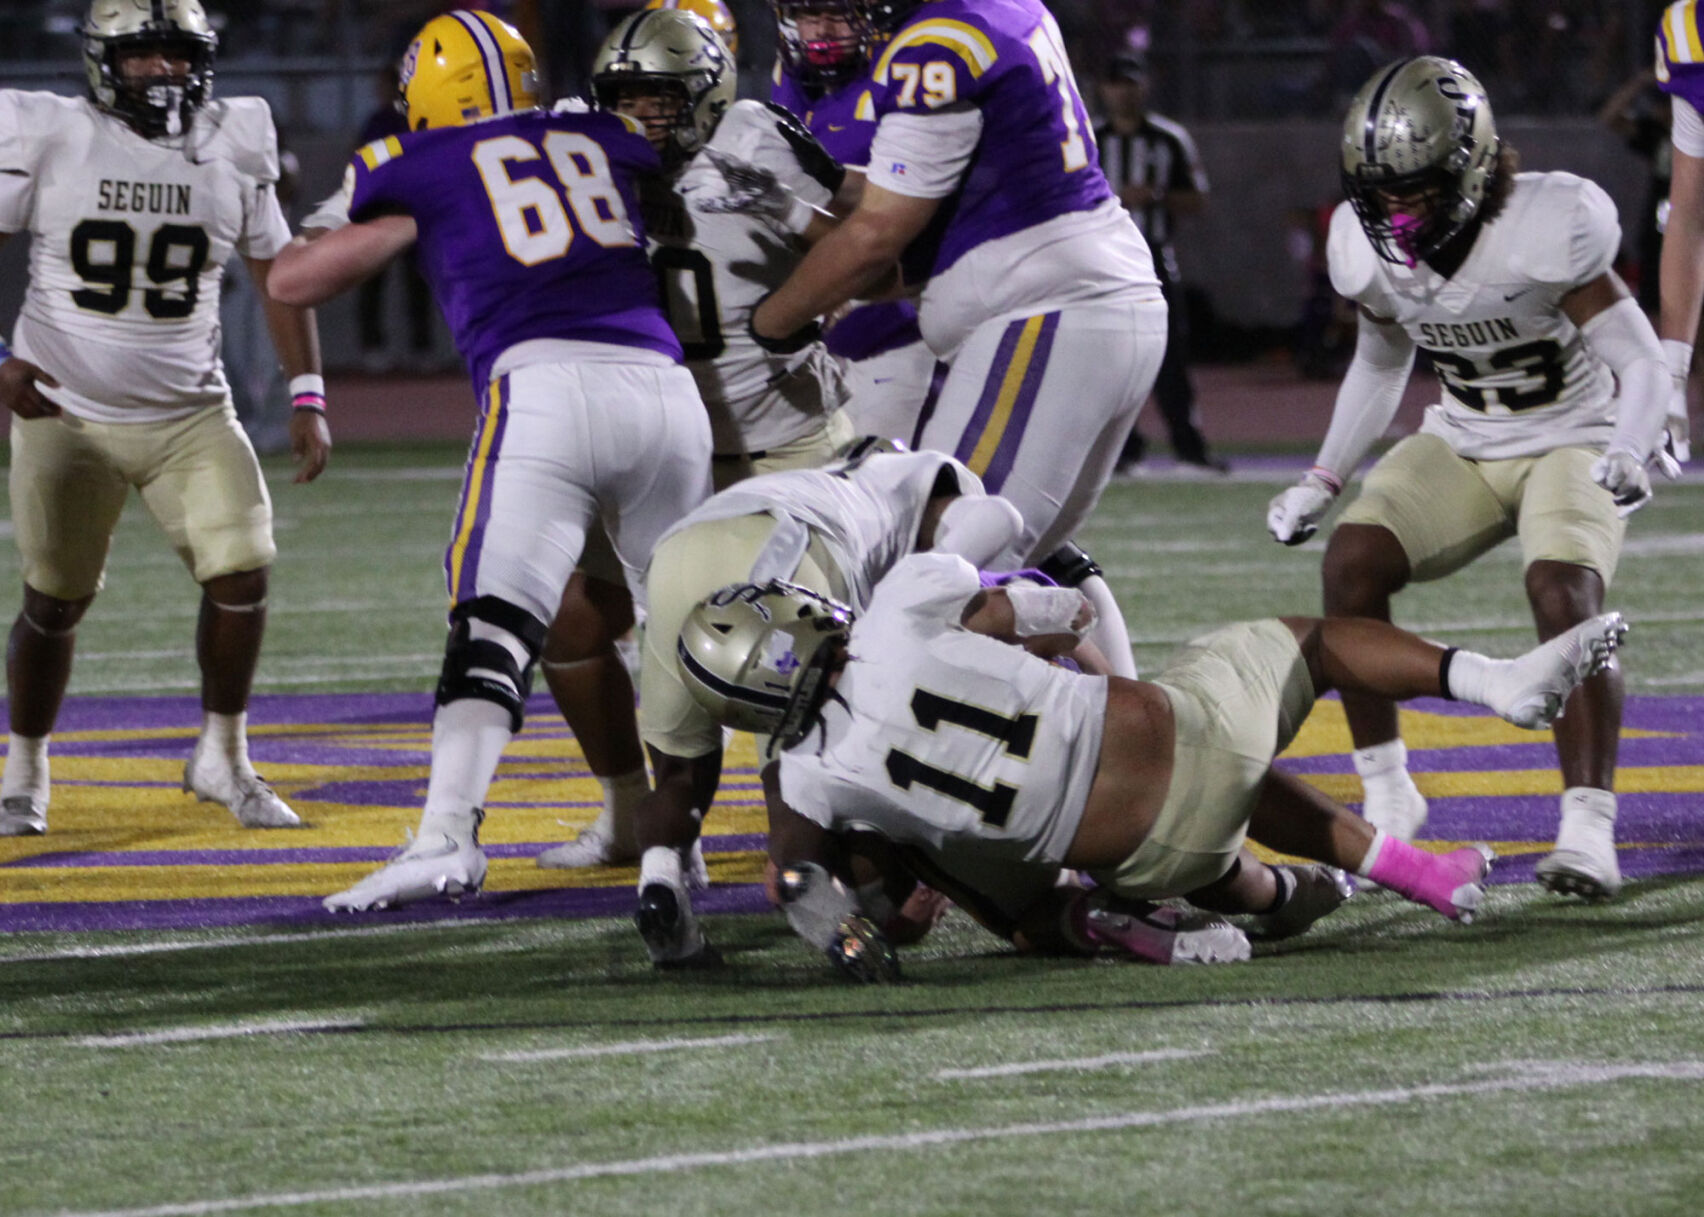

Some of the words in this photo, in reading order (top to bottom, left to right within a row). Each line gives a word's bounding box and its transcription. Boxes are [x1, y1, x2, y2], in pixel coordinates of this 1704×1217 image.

[891, 60, 957, 110] 79
[98, 179, 191, 215] SEGUIN
[471, 130, 638, 267] 68
[70, 218, 210, 320] 99
[1419, 317, 1520, 347] SEGUIN
[1432, 337, 1564, 416] 23
[884, 683, 1042, 832] 11
